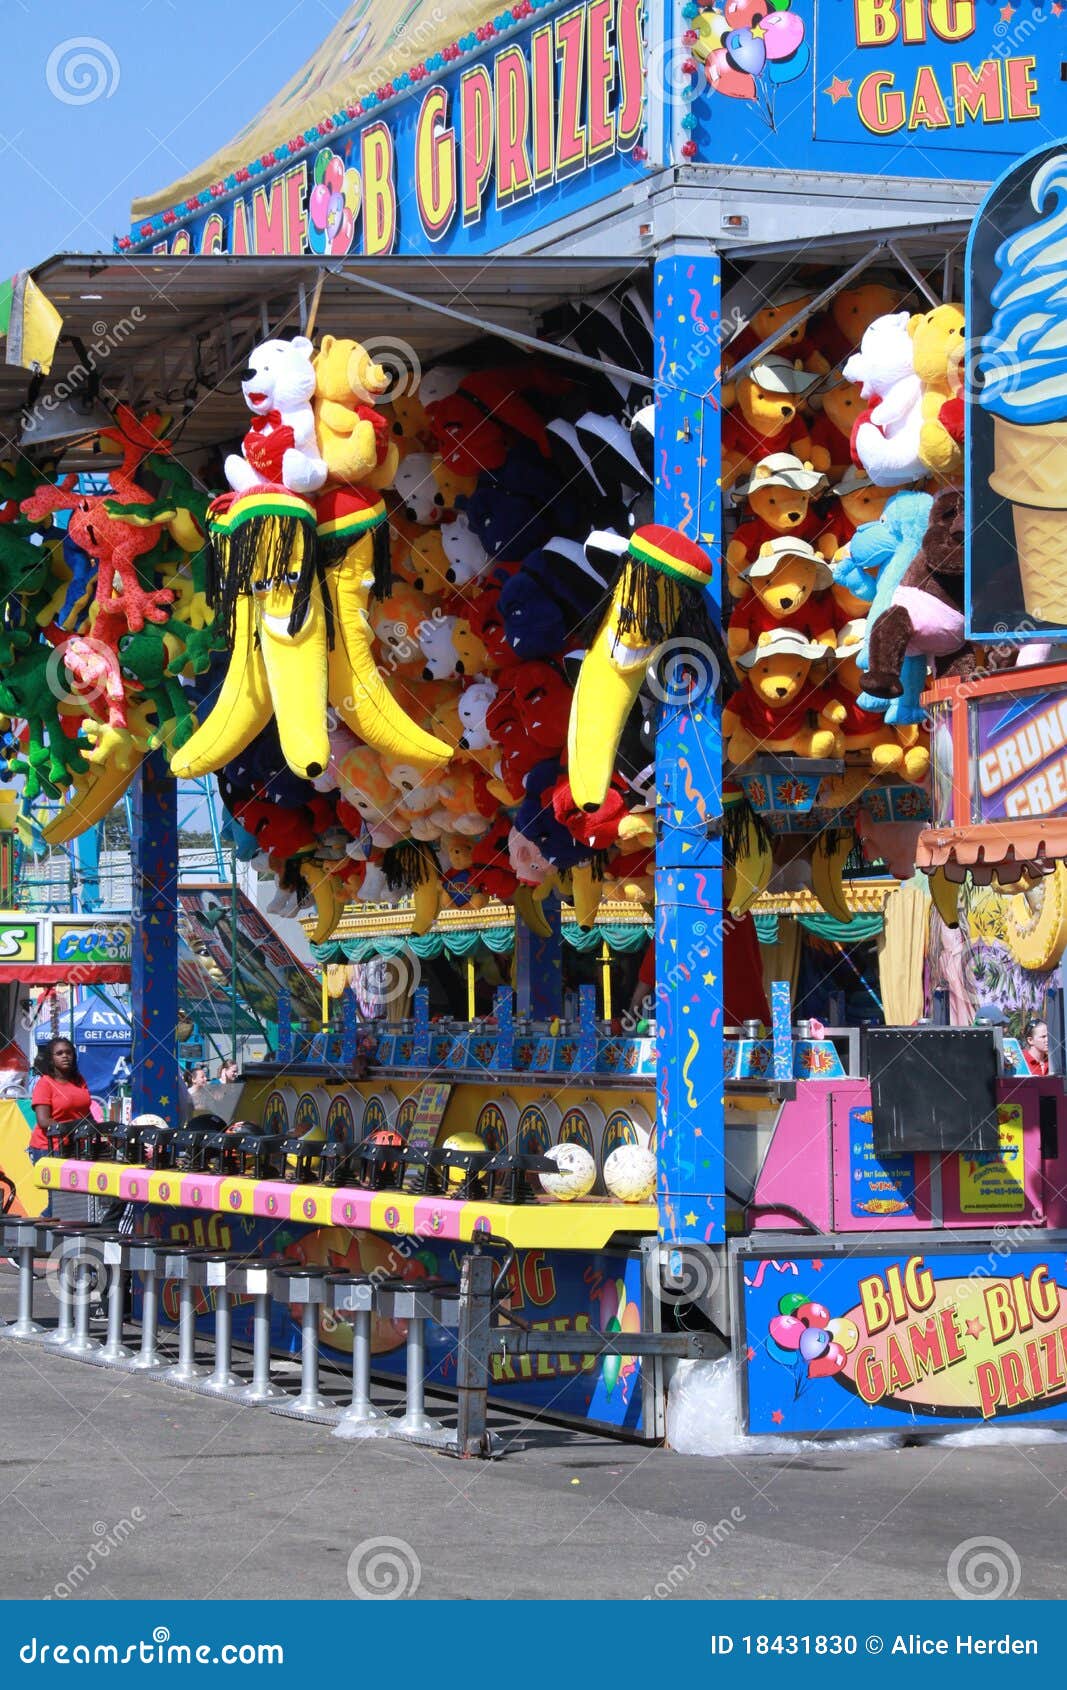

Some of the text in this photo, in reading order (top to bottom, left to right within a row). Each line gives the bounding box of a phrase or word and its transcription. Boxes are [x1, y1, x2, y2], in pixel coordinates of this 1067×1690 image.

[856, 0, 976, 48] BIG
[460, 0, 644, 229] PRIZES
[857, 56, 1041, 135] GAME
[1004, 752, 1067, 818] CRE
[57, 929, 126, 960] COLD
[107, 943, 132, 958] DRI
[84, 1030, 131, 1039] GET CASH
[858, 1255, 936, 1336] BIG
[983, 1263, 1061, 1346] BIG
[854, 1303, 967, 1405] GAME
